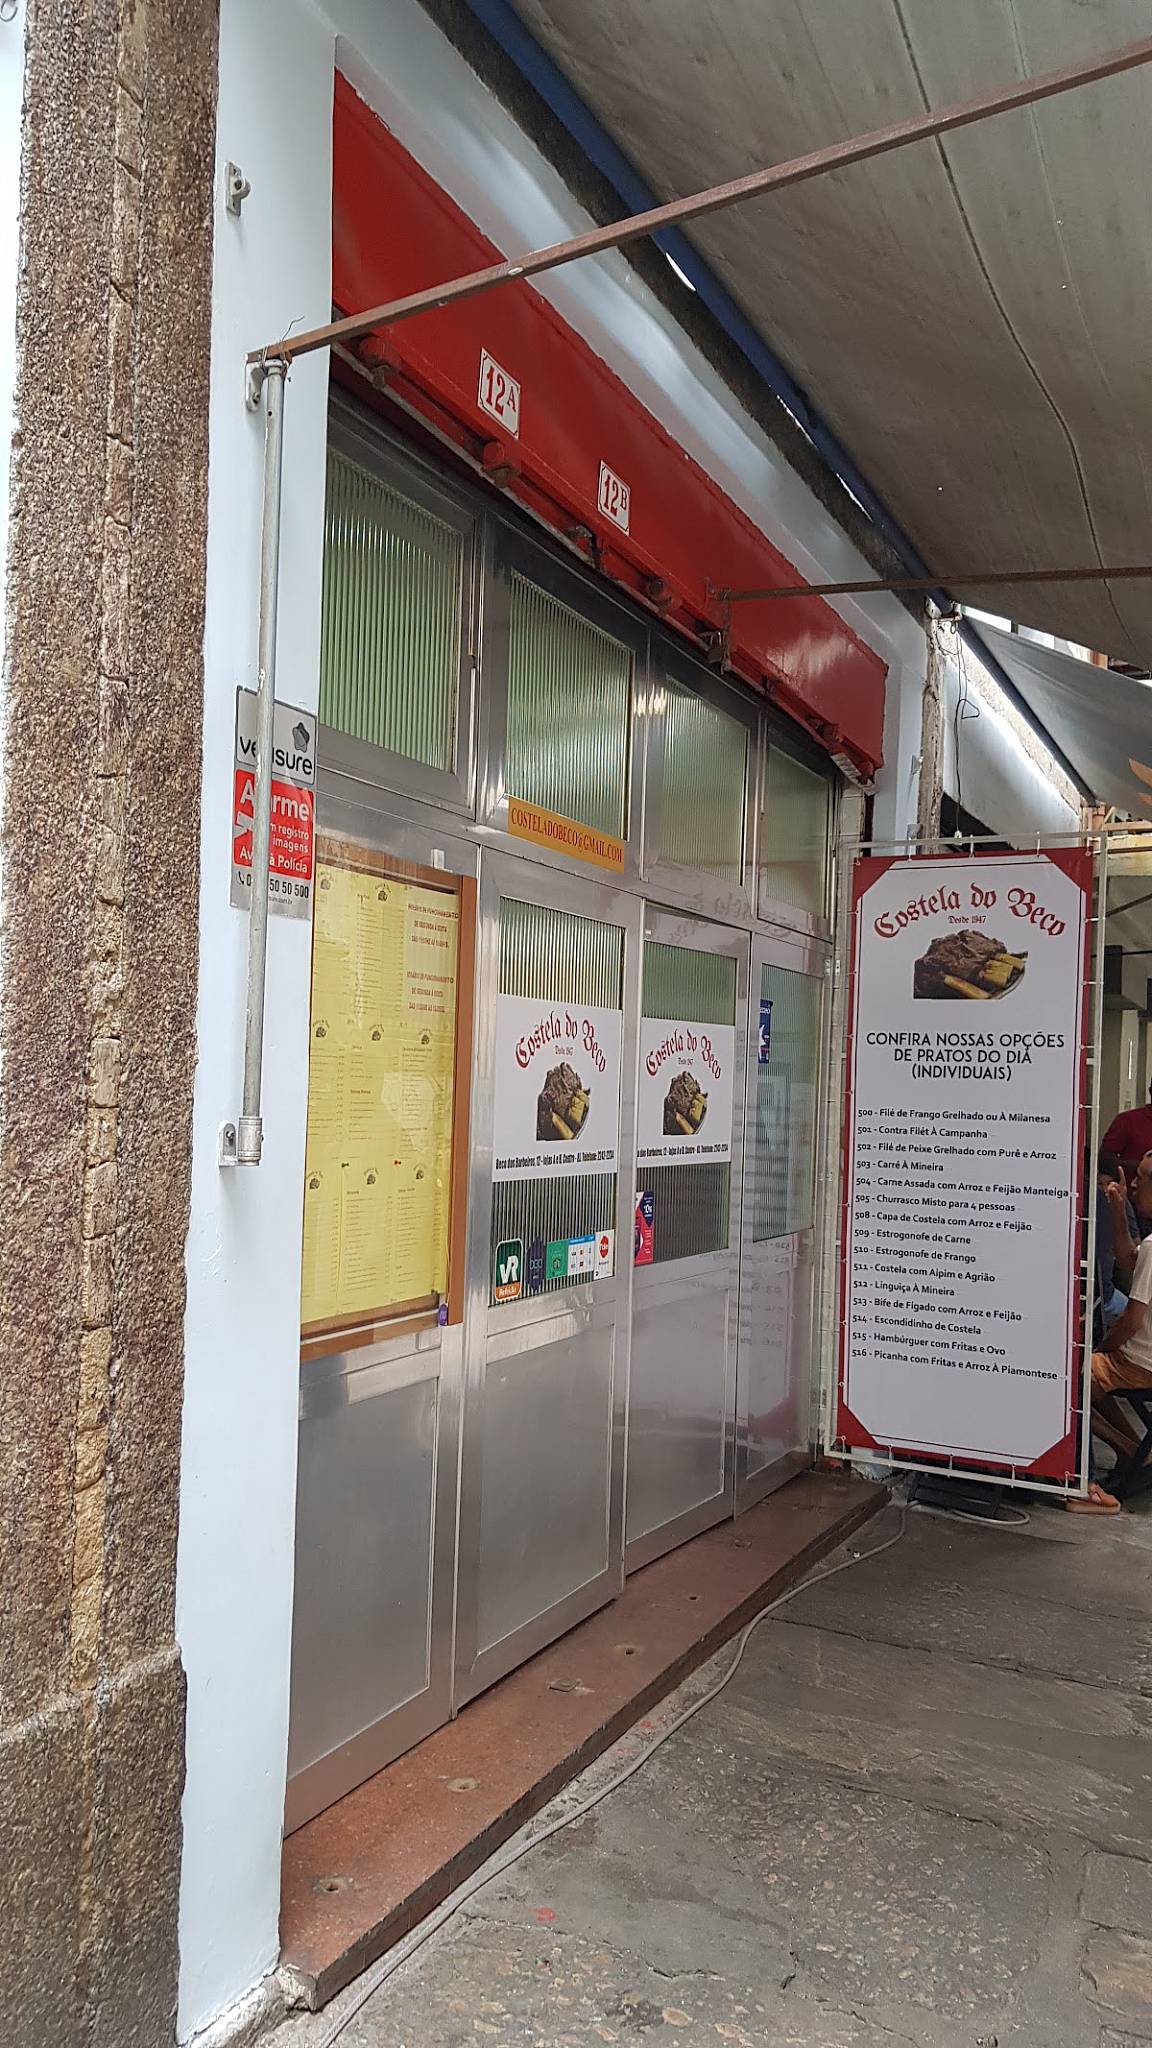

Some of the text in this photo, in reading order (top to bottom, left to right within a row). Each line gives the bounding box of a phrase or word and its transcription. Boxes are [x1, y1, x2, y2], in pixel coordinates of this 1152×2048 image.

[240, 778, 310, 822] Arme
[278, 826, 310, 840] registro
[272, 834, 309, 853] imagens
[277, 854, 308, 873] Polícia
[874, 882, 1067, 938] Costela do Beco
[948, 915, 970, 924] Desde
[515, 1010, 607, 1073] Costela do Beco
[866, 1032, 1065, 1050] CONFIRA NOSSAS OPÇÕES
[646, 1028, 684, 1077] Costela
[686, 1028, 698, 1053] do
[894, 1049, 912, 1062] DE
[917, 1050, 973, 1063] PRATOS
[977, 1050, 1001, 1063] DO
[911, 1063, 1012, 1082] (INDIVIDUAIS)
[880, 1108, 895, 1117] Filé
[897, 1109, 907, 1117] de
[910, 1110, 940, 1120] Frango
[942, 1110, 983, 1120] Grelhado
[999, 1112, 1006, 1121] À
[1009, 1113, 1050, 1123] Milanesa
[879, 1126, 908, 1134] Contra
[930, 1126, 937, 1136] À
[939, 1128, 987, 1139] Campanha
[879, 1142, 893, 1151] Filé
[895, 1144, 906, 1152] de
[909, 1144, 932, 1153] Peixe
[934, 1146, 975, 1155] Grelhado
[1030, 1150, 1056, 1159] Arroz
[857, 1161, 870, 1169] 503
[878, 1160, 900, 1169] Carré
[902, 1160, 908, 1170] À
[911, 1162, 943, 1171] Mineira
[856, 1178, 871, 1186] 504
[878, 1178, 902, 1186] Carne
[904, 1179, 935, 1188] Assada
[958, 1182, 983, 1192] Arroz
[993, 1184, 1021, 1196] Feijão
[1024, 1186, 1068, 1199] Manteiga
[856, 1195, 870, 1203] 505
[877, 1194, 920, 1204] Churrasco
[922, 1197, 947, 1206] Misto
[948, 1201, 968, 1209] para
[979, 1203, 1015, 1211] pessoas
[855, 1211, 870, 1220] 508
[877, 1212, 898, 1222] Capa
[900, 1213, 910, 1222] de
[913, 1214, 945, 1224] Costela
[968, 1219, 994, 1228] Arroz
[1004, 1221, 1032, 1232] Feijão
[854, 1229, 869, 1237] 509
[877, 1229, 930, 1241] Estrogonofe
[932, 1233, 943, 1242] de
[945, 1235, 971, 1244] Carne
[854, 1246, 868, 1254] 510
[876, 1246, 929, 1258] Estrogonofe
[931, 1251, 942, 1259] de
[944, 1252, 976, 1264] Frango
[875, 1264, 906, 1274] Costela
[909, 1268, 927, 1276] com
[929, 1268, 955, 1279] Aipim
[965, 1272, 995, 1282] Agrião
[875, 1280, 910, 1294] Linguiça
[913, 1283, 919, 1293] À
[922, 1285, 954, 1296] Mineira
[853, 1298, 867, 1306] 513
[874, 1298, 891, 1307] Bife
[893, 1300, 904, 1308] de
[938, 1306, 956, 1314] com
[959, 1307, 983, 1317] Arroz
[994, 1310, 1021, 1322] Feijão
[852, 1315, 867, 1324] 514
[875, 1315, 932, 1329] Escondidinho
[935, 1321, 946, 1330] de
[948, 1324, 981, 1334] Costela
[853, 1332, 866, 1341] 515
[874, 1333, 928, 1346] Hambúrguer
[952, 1342, 977, 1352] Fritas
[987, 1346, 1005, 1355] Ovo
[852, 1349, 866, 1357] 516
[874, 1350, 908, 1361] Picanha
[910, 1356, 929, 1364] com
[931, 1357, 956, 1367] Fritas
[965, 1361, 990, 1372] Arroz
[992, 1362, 1000, 1372] À
[1002, 1365, 1057, 1380] Piamontese
